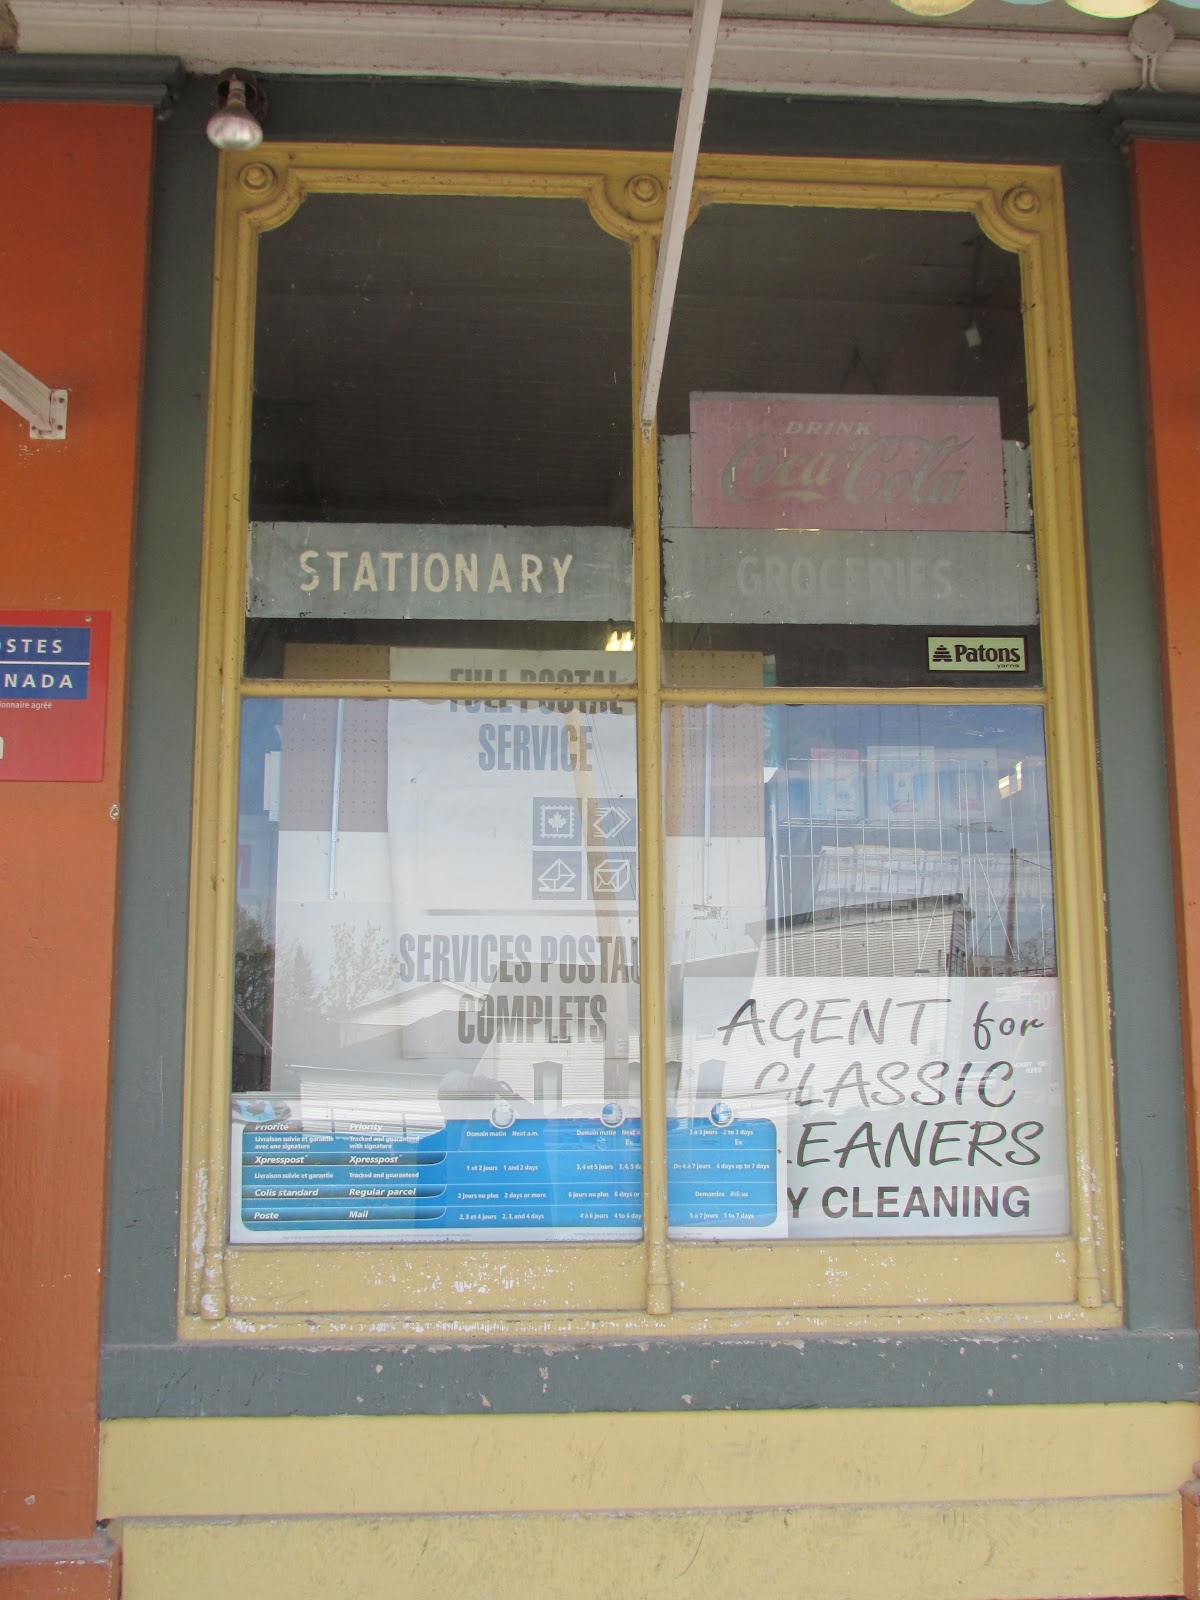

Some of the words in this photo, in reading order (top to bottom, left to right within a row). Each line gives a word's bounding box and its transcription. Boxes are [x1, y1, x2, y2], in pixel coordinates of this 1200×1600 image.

[784, 421, 873, 436] DRINK
[720, 432, 840, 502] Coca
[843, 434, 976, 505] Cola
[299, 550, 573, 594] STATIONARY
[736, 556, 953, 598] GROCERIES
[0, 639, 62, 653] STES
[954, 644, 1021, 662] Patons
[5, 673, 73, 688] NADA
[449, 668, 514, 714] FULL
[520, 669, 623, 715] POSTAL
[31, 701, 52, 711] agréé
[478, 722, 593, 772] SERVICE
[399, 933, 532, 984] SERVICES
[457, 993, 607, 1045] COMPLETS
[717, 998, 952, 1058] AGENT
[972, 1001, 1044, 1050] for
[754, 1060, 1016, 1108] CLASSIC
[349, 1122, 384, 1134] Priority
[254, 1135, 282, 1143] Livraison
[282, 1135, 301, 1143] suivie
[349, 1135, 372, 1143] Tracked
[373, 1135, 385, 1143] and
[787, 1120, 1044, 1168] EANERS
[281, 1143, 311, 1151] signature
[363, 1143, 393, 1151] signature
[308, 1172, 334, 1180] garantie
[385, 1172, 419, 1180] guaranteed
[254, 1188, 277, 1197] Colis
[278, 1188, 319, 1197] standard
[349, 1188, 386, 1197] Regular
[387, 1188, 417, 1197] parcel
[822, 1185, 1030, 1218] CLEANING
[254, 1211, 280, 1219] Poste
[349, 1210, 369, 1218] Mail
